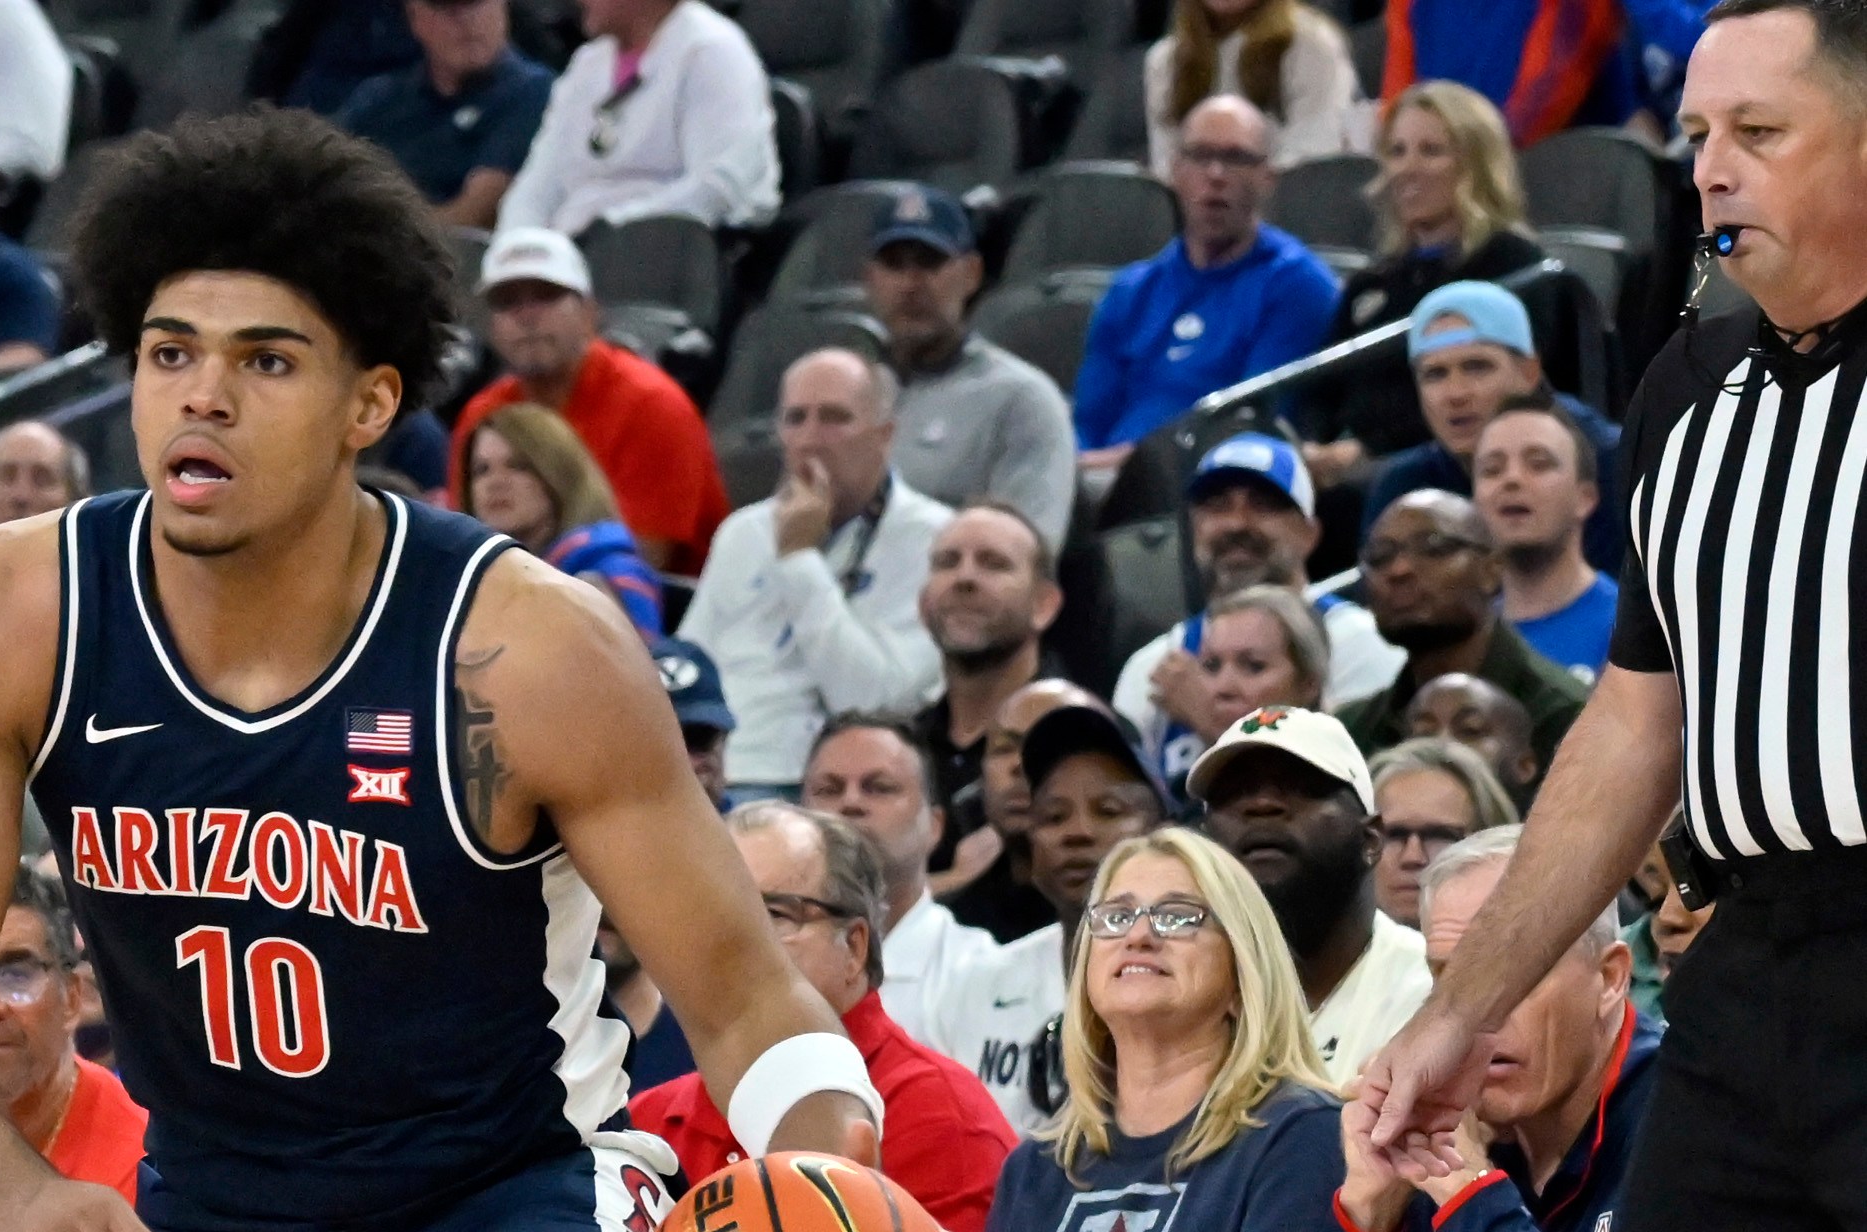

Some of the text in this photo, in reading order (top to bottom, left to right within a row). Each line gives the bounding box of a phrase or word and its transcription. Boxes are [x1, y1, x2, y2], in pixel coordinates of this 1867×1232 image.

[351, 768, 407, 802] XII
[71, 806, 430, 934] ARIZONA
[175, 925, 331, 1079] 10
